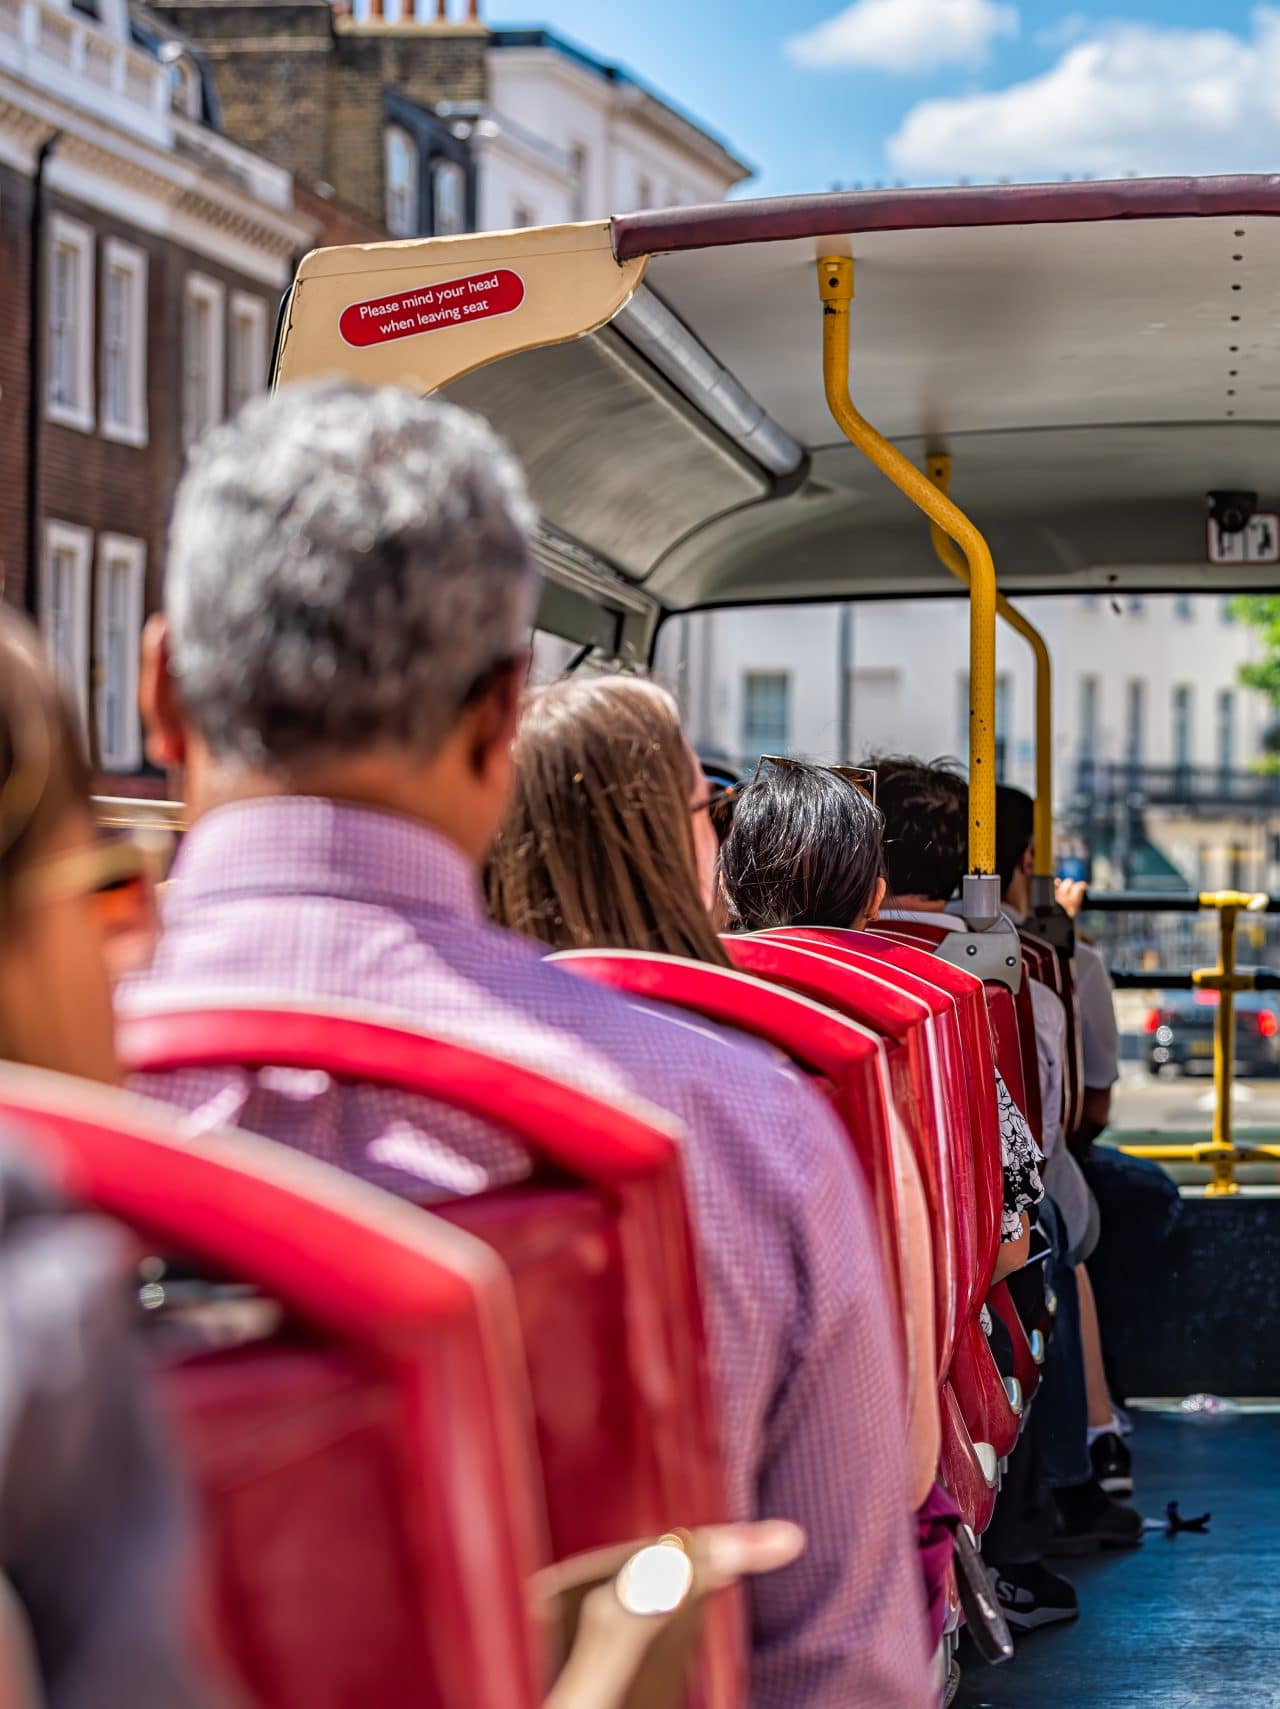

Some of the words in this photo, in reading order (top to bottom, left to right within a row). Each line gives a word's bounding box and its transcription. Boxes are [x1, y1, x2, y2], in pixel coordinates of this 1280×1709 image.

[360, 301, 399, 320] Please
[402, 291, 434, 309] mind
[435, 285, 465, 304] your
[468, 275, 499, 294] head
[379, 318, 415, 334] when
[417, 307, 461, 326] leaving
[463, 299, 489, 314] seat
